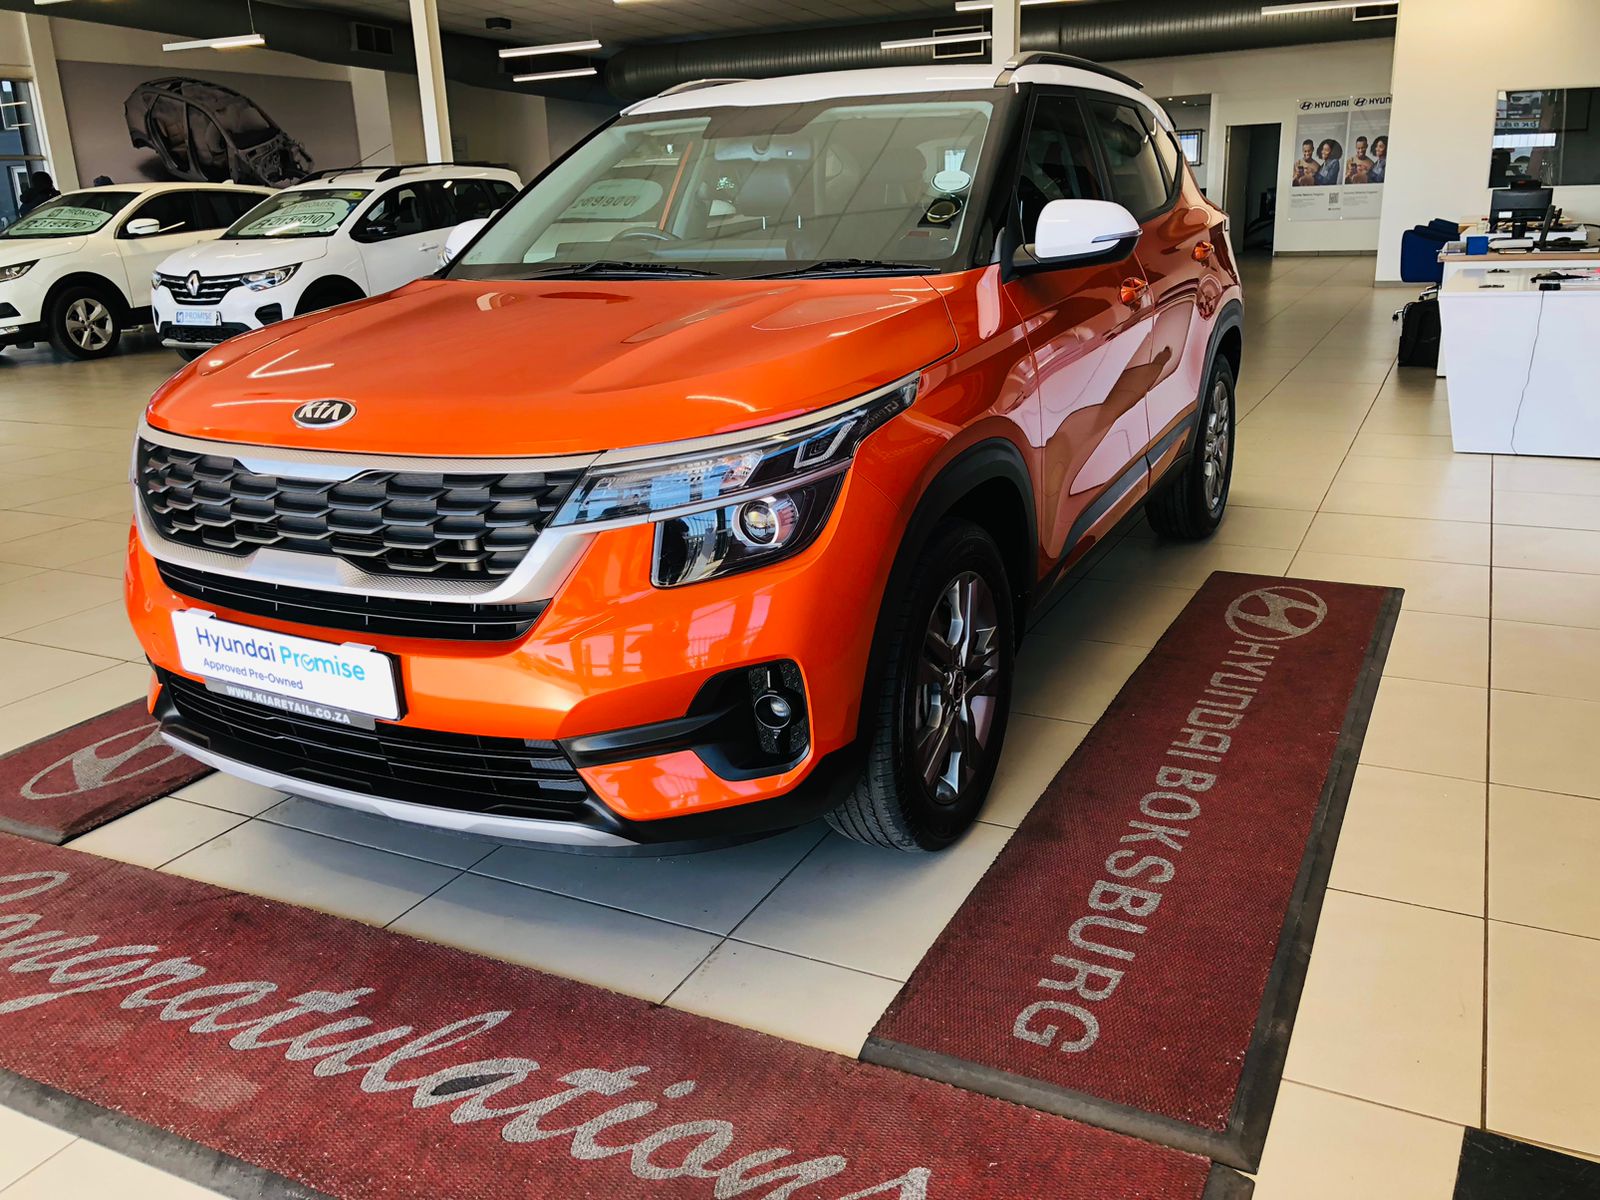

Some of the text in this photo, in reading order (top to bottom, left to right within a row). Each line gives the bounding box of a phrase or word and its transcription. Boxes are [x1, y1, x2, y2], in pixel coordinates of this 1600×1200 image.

[1314, 100, 1349, 108] HYUNDAI
[1369, 97, 1392, 105] HYUN
[184, 311, 212, 321] PROMISE
[299, 402, 344, 420] KIA
[195, 626, 366, 681] Hyundai Promise
[203, 657, 304, 690] Approved Pre-Owned
[226, 685, 351, 724] WWW.KIARETAIL.CO.ZA
[1012, 639, 1281, 1054] HYUNDAI BOKSBURG
